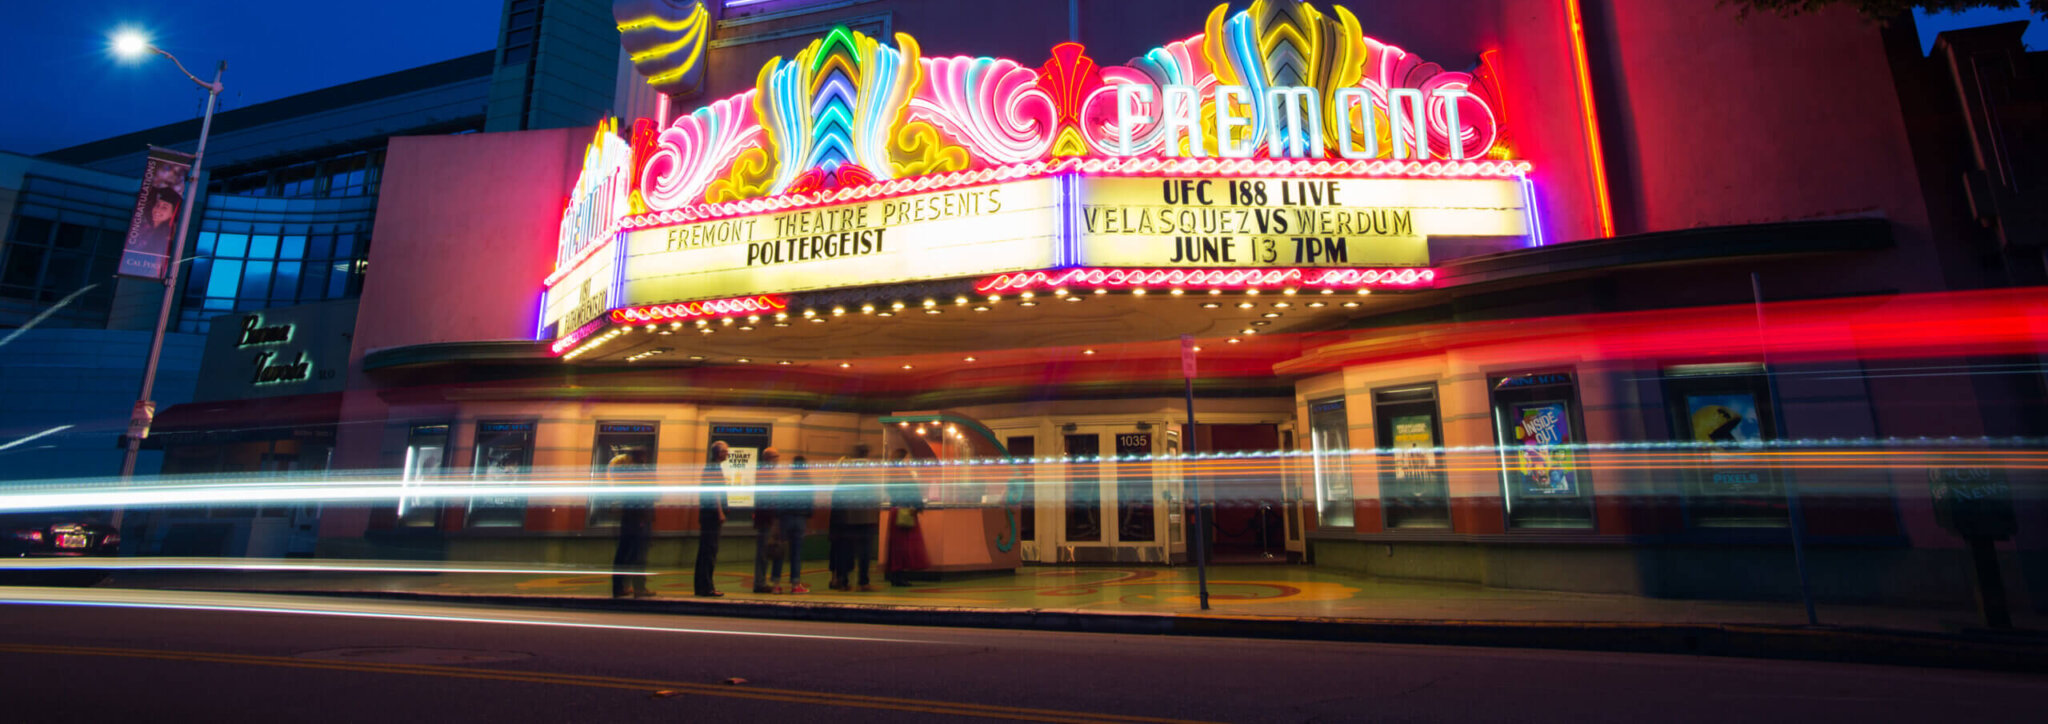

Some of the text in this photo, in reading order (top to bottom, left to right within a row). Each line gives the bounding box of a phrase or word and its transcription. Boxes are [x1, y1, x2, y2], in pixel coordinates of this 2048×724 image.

[1117, 84, 1467, 160] FREMONT
[128, 160, 157, 245] CONGRATULATIONS
[1163, 180, 1342, 206] UFC 188 LIVE
[667, 189, 1002, 252] FREMONT THEATRE PRESENTS
[1083, 207, 1414, 234] VELASQUEZ VS WERDUM
[746, 228, 887, 266] POLTERGEIST
[1169, 237, 1348, 264] JUNE 13 7PM
[1521, 411, 1559, 437] INSIDE
[1535, 424, 1558, 444] OUT
[1120, 435, 1147, 447] 1035
[1713, 473, 1758, 484] PIXELS
